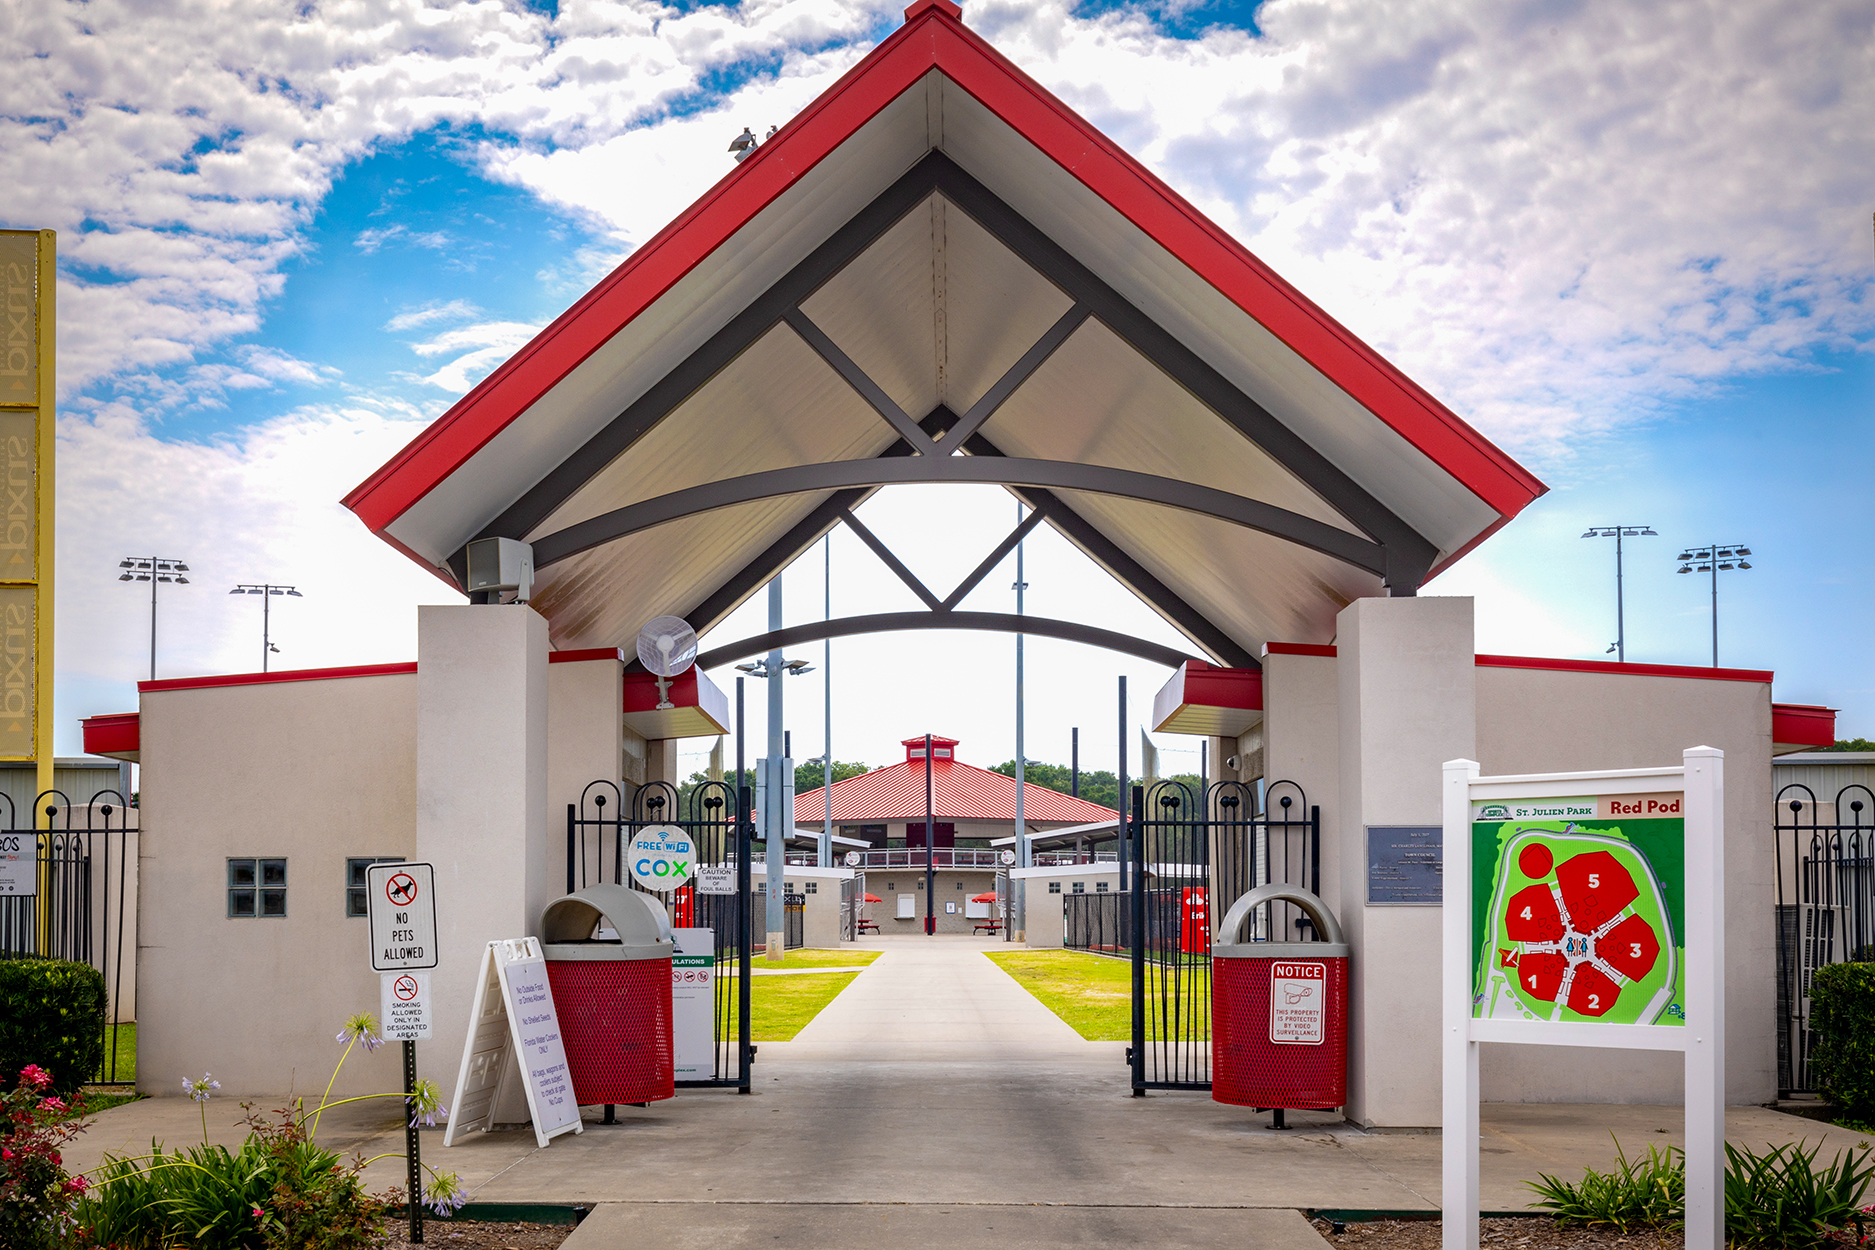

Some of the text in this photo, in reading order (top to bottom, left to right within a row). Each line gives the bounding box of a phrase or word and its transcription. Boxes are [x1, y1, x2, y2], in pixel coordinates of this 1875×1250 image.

[1516, 806, 1592, 817] ST. JULIEN PARK
[1610, 799, 1681, 815] Red Pod
[0, 836, 20, 851] OS
[636, 841, 662, 851] FREE
[635, 858, 688, 878] COX
[1588, 873, 1600, 889] 5
[396, 912, 408, 924] NO
[1520, 906, 1533, 921] 4
[392, 929, 413, 942] PETS
[383, 946, 423, 960] ALLOWED
[1629, 943, 1642, 958] 3
[1276, 965, 1320, 978] NOTICE
[1528, 974, 1537, 989] 1
[1588, 994, 1600, 1009] 2
